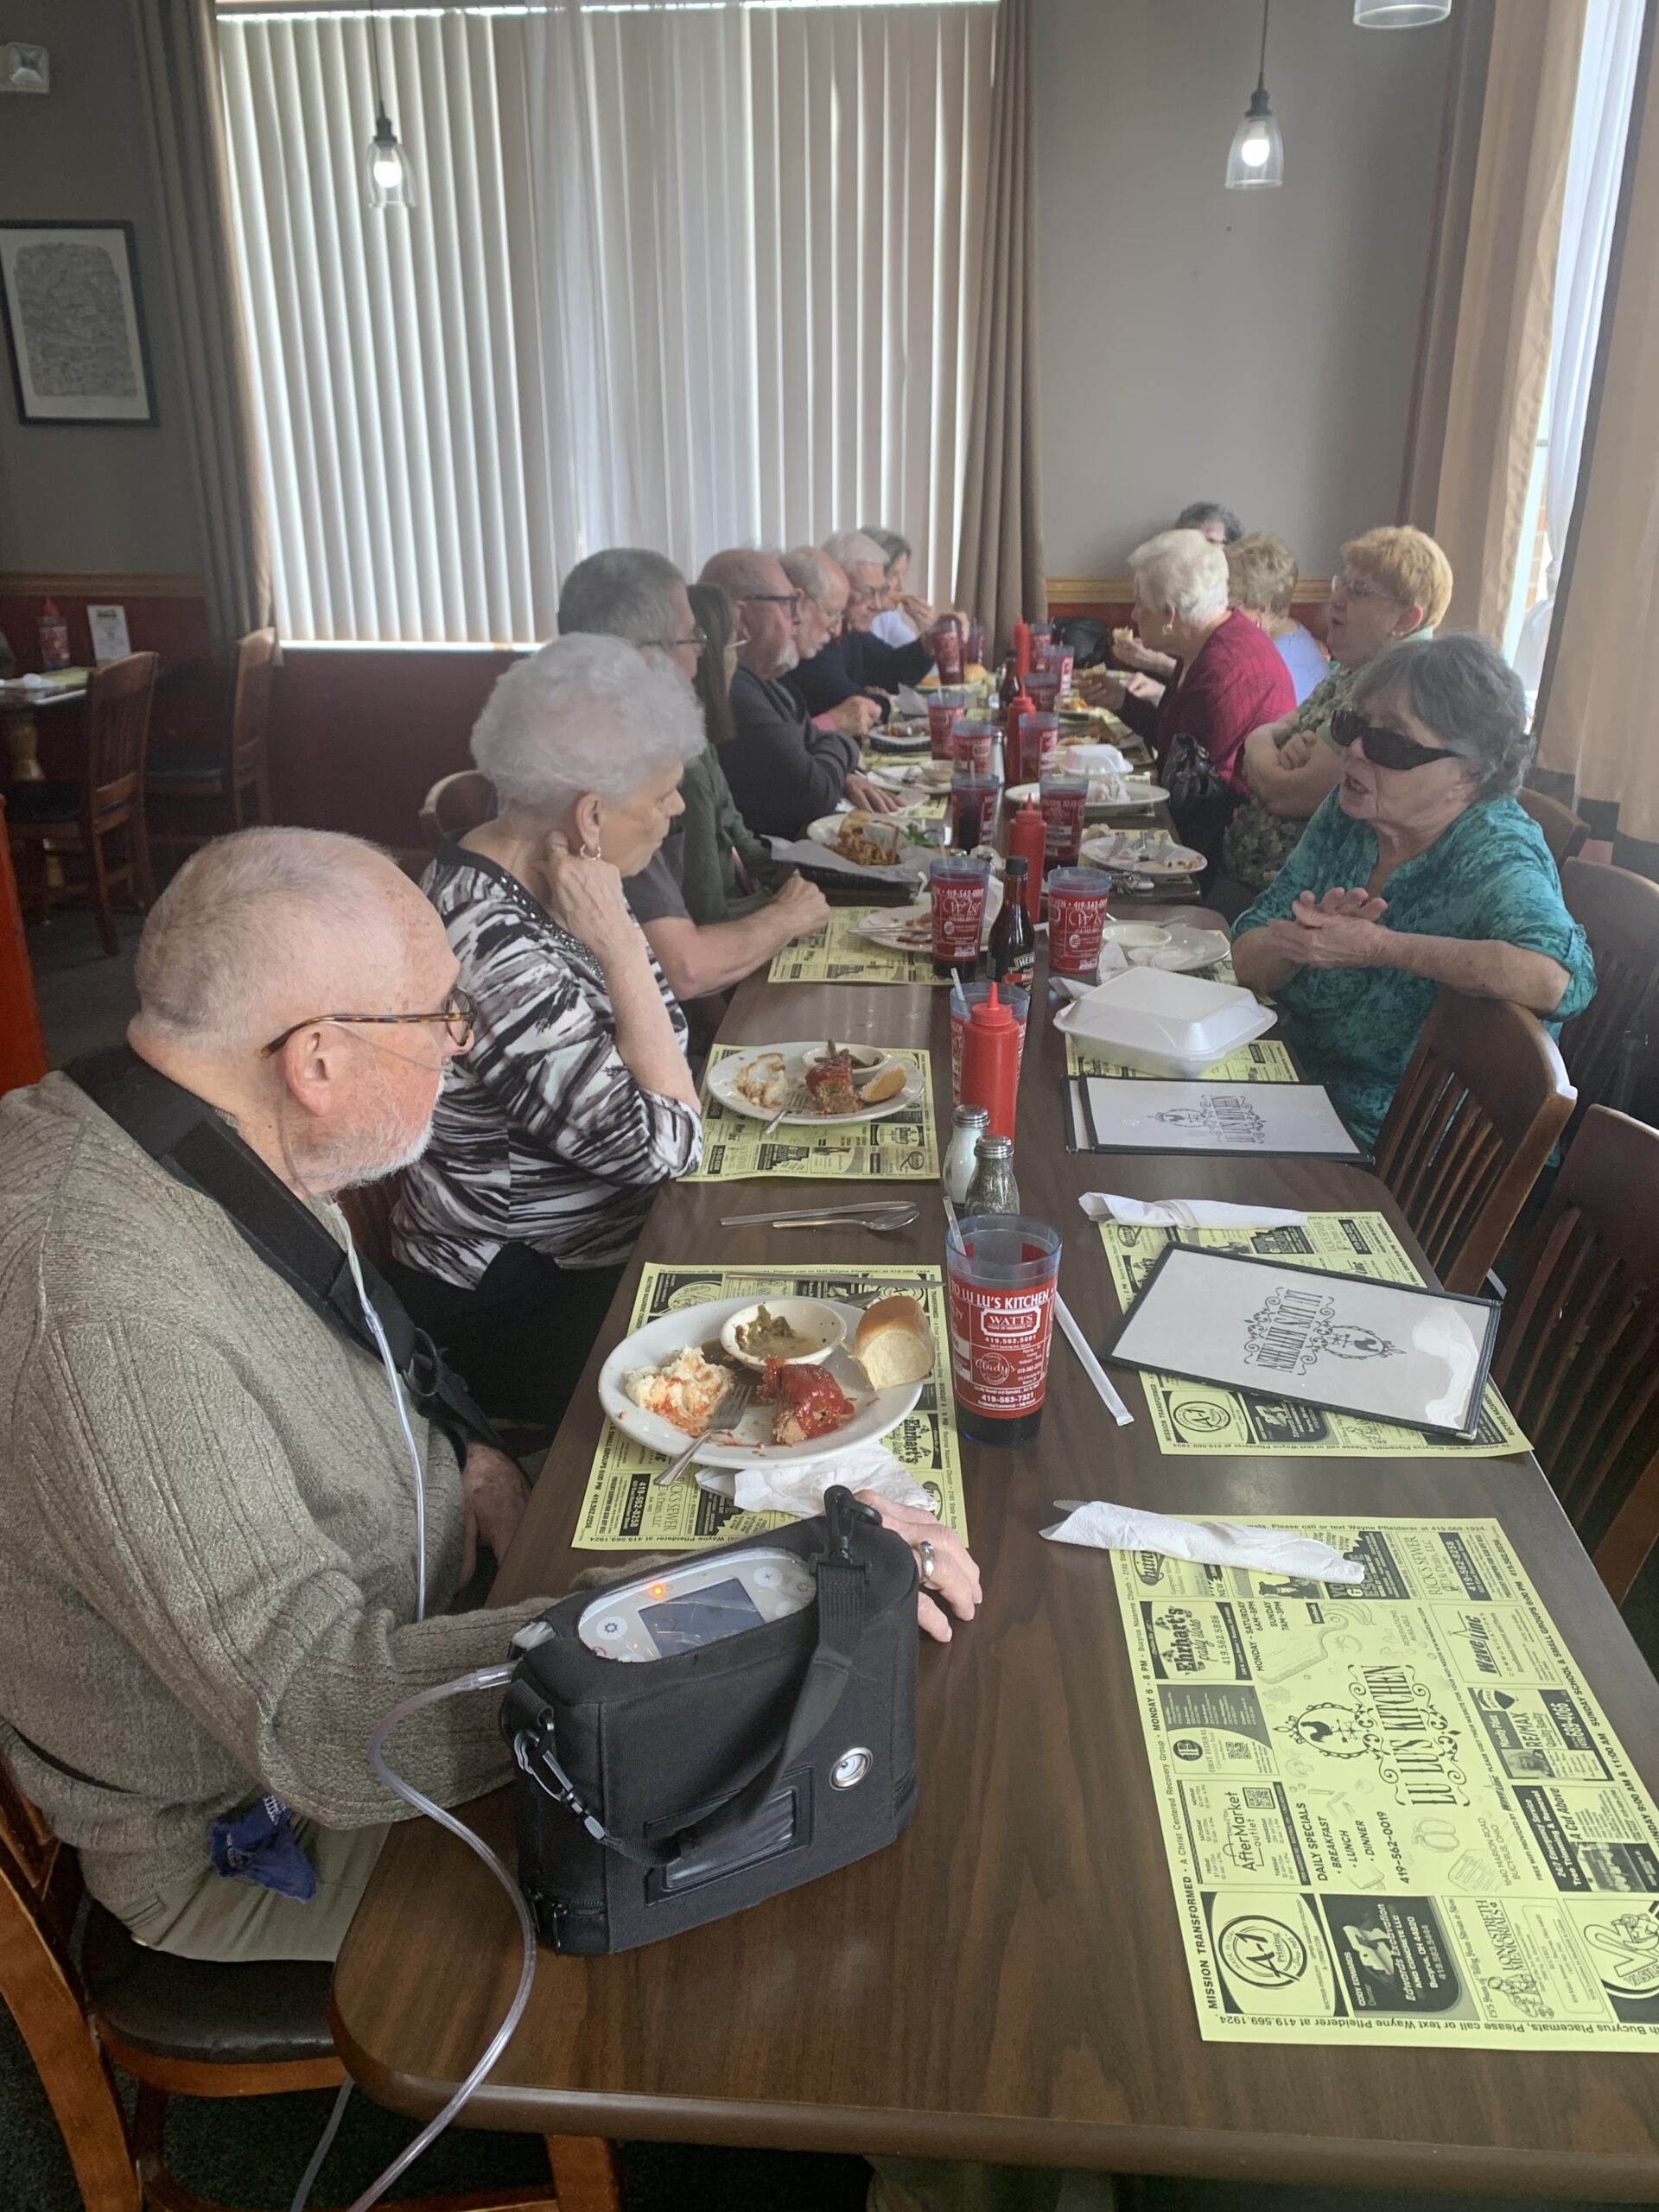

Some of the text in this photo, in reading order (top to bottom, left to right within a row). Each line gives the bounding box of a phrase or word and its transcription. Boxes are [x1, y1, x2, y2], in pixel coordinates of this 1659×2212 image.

[963, 1287, 974, 1303] LU
[976, 1293, 1001, 1309] LU'S
[1005, 1287, 1049, 1309] KITCHEN
[989, 1313, 1033, 1325] WATTS
[1256, 1289, 1323, 1373] LU LU'S KITCHEN
[1150, 1383, 1165, 1418] TRANSFORMED
[1184, 1408, 1224, 1428] A-1
[904, 1419, 923, 1463] Ehrhart's
[600, 1447, 611, 1468] GROUPS
[629, 1481, 646, 1527] 419-562-8258
[663, 1503, 680, 1531] SEWER
[652, 1516, 662, 1527] LLC
[1421, 1539, 1435, 1551] LLC
[1492, 1539, 1516, 1576] 419.562.0256
[1403, 1535, 1442, 1594] RICK'S SEWER
[1430, 1553, 1445, 1572] Drain,
[1446, 1541, 1476, 1591] 419-562-8258
[1125, 1582, 1134, 1600] Church
[1216, 1583, 1225, 1596] NEW
[1515, 1581, 1525, 1590] PM
[1521, 1592, 1533, 1605] 6:00
[1130, 1602, 1139, 1626] Nazarene
[1247, 1601, 1262, 1630] 6AM-8PM
[1263, 1601, 1277, 1626] SUNDAY
[1273, 1601, 1288, 1630] 7AM-3PM
[1389, 1610, 1409, 1646] RESERVATIONS
[1400, 1615, 1416, 1641] AVAILABLE
[1465, 1615, 1489, 1640] Linc
[1529, 1606, 1548, 1633] GROUPS
[1135, 1629, 1145, 1651] Bucyrus
[1166, 1608, 1196, 1671] Ehrhart's
[1210, 1615, 1230, 1664] 419.562.5886
[1236, 1601, 1263, 1670] MONDAY SATURDAY
[1479, 1612, 1514, 1676] COMMUNICATIONS
[1545, 1635, 1561, 1656] SMALL
[1139, 1660, 1148, 1671] PM
[1469, 1639, 1497, 1673] Wave
[1561, 1666, 1582, 1694] SCHOOL
[1147, 1697, 1160, 1730] MONDAY
[1550, 1702, 1583, 1736] 689-4066
[1577, 1696, 1599, 1726] SUNDAY
[1363, 1665, 1457, 1804] LU LU'S KITCHEN
[1495, 1729, 1510, 1746] Mandy
[1510, 1712, 1542, 1747] RE/MAX
[1532, 1712, 1556, 1746] Quality Realty
[1597, 1732, 1610, 1745] AM
[1157, 1740, 1166, 1760] Group
[1199, 1729, 1215, 1771] FIRST FEDERAL
[1605, 1746, 1622, 1768] 11:00
[1162, 1763, 1173, 1794] Recovery
[1622, 1779, 1636, 1791] AM
[1168, 1797, 1181, 1829] Centered
[1531, 1789, 1551, 1821] Removal
[1549, 1787, 1570, 1814] Above
[1630, 1793, 1646, 1811] 9:00
[1225, 1791, 1255, 1871] AfterMarket
[1246, 1818, 1262, 1846] outlet
[1512, 1821, 1529, 1849] PROVIDED
[1560, 1815, 1578, 1830] Cut
[1175, 1833, 1186, 1855] Christ
[1296, 1802, 1327, 1880] DAILY SPECIALS
[1318, 1815, 1341, 1867] BREAKFAST
[1338, 1829, 1357, 1861] LUNCH
[1355, 1820, 1375, 1855] DINNER
[1376, 1811, 1408, 1883] 419-562-0019
[1477, 1817, 1512, 1885] 1640 MARION ROAD
[1491, 1824, 1520, 1878] BUCYRUS, OHIO
[1525, 1798, 1566, 1877] 24/7 Emergency Service
[1551, 1830, 1572, 1866] Trimming
[1525, 1851, 1535, 1863] WIFI
[1532, 1865, 1542, 1879] FREE
[1569, 1867, 1581, 1885] Tree
[1182, 1876, 1205, 1953] TRANSFORMED
[1272, 1932, 1285, 1962] Printing
[1476, 1899, 1515, 1970] LONGSTRETH
[1492, 1909, 1523, 1970] MEMORIALS
[1234, 1931, 1300, 1981] A-1
[1377, 1904, 1415, 2000] Edwards Excavation
[1392, 1914, 1422, 1988] AND CONCRETE LLC
[1407, 1916, 1438, 1987] Bucyrus, OH 44820
[1199, 1960, 1217, 2008] MISSION
[1344, 1951, 1365, 2005] CODY EDWARDS
[1214, 2013, 1296, 2026] 419.569.1924.
[1314, 2018, 1373, 2029] Pfleiderer
[1375, 2018, 1415, 2030] Wayne
[1418, 2020, 1441, 2030] text
[1460, 2021, 1481, 2031] call
[1484, 2022, 1525, 2032] Please
[1528, 2023, 1593, 2034] Placemats,
[1598, 2024, 1648, 2035] Bucyrus
